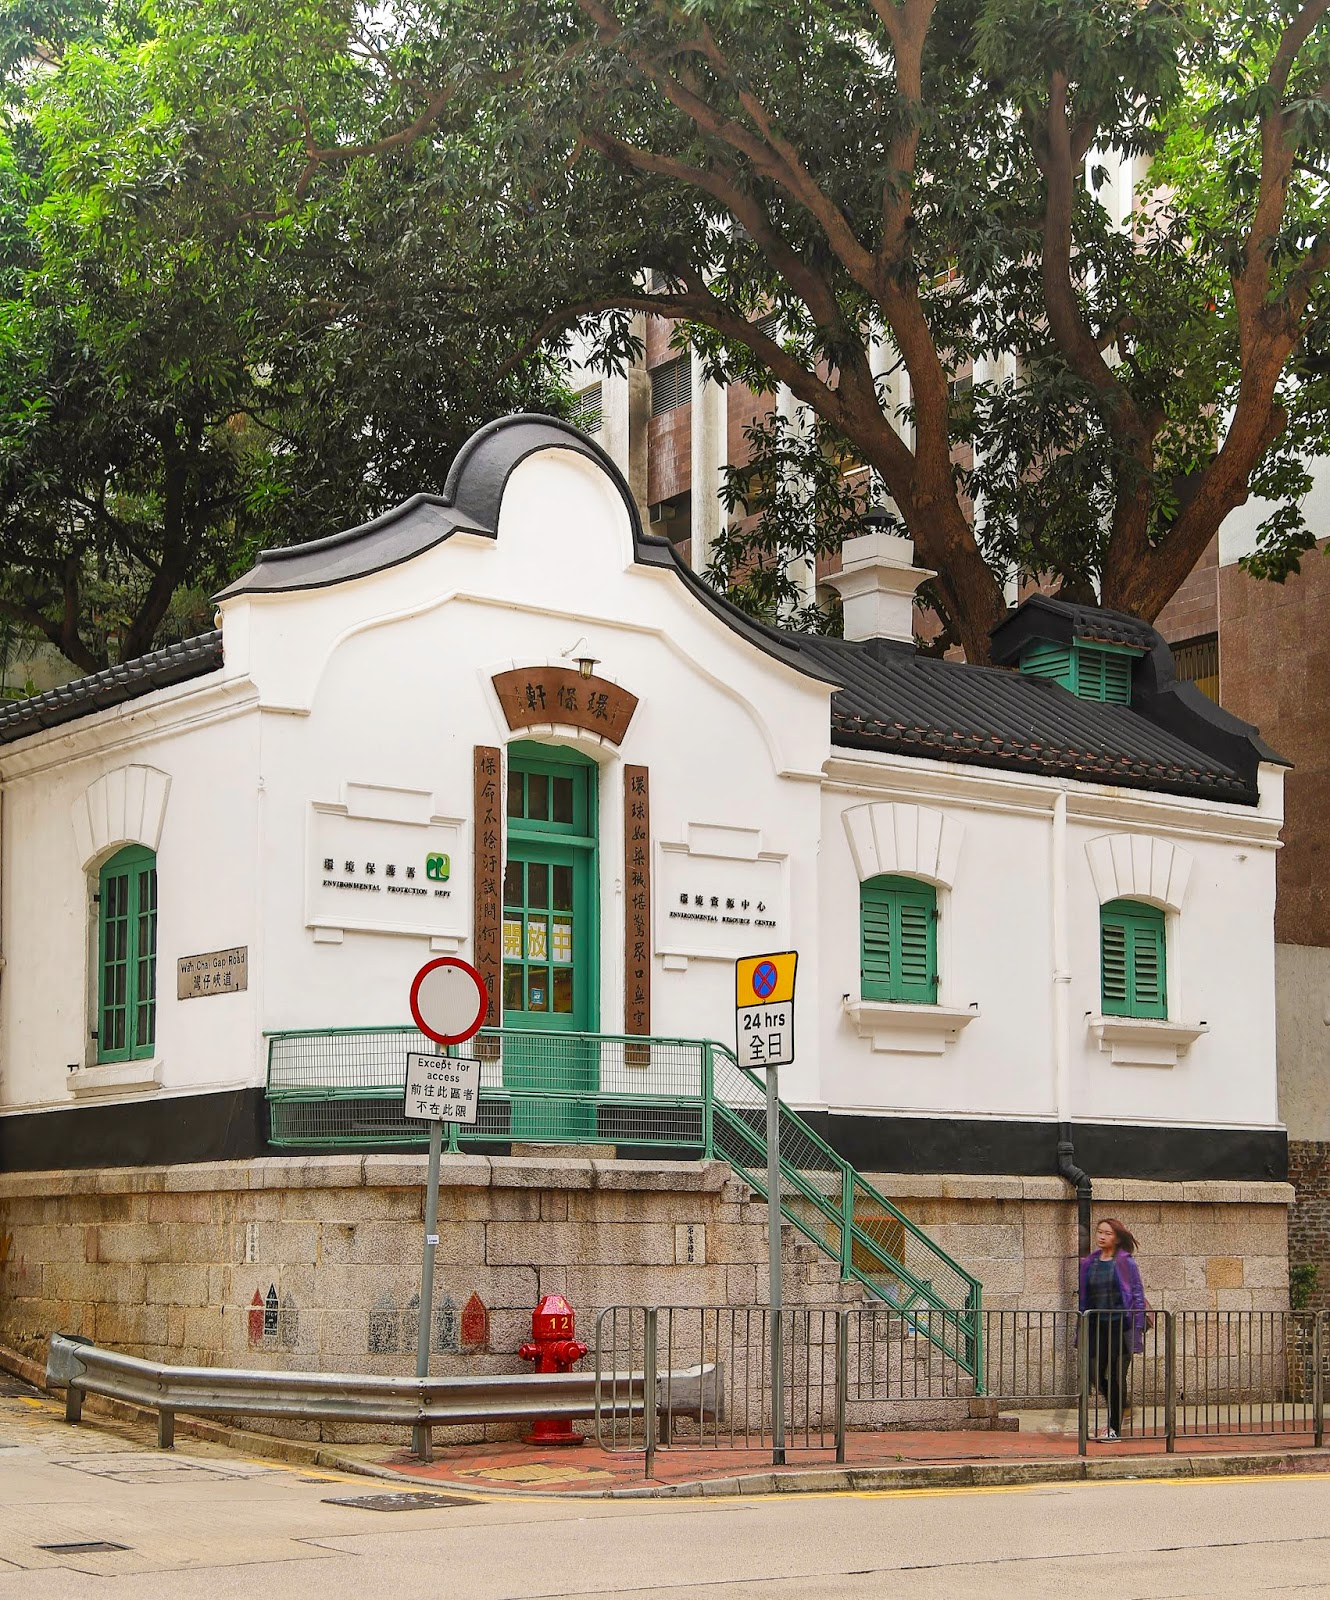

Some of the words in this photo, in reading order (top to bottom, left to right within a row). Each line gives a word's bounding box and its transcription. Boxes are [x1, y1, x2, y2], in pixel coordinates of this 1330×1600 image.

[323, 858, 417, 879] 環境保護署
[323, 880, 381, 891] ENVIRONMENTAL
[388, 886, 427, 896] PROTECTION
[680, 893, 766, 912] 環境資源中心
[670, 911, 719, 922] ENVIRONMENTAL
[722, 916, 750, 925] RESOURCE
[754, 919, 776, 927] CENTRE
[503, 924, 572, 959] 開放中
[212, 957, 226, 969] Gap
[228, 954, 245, 965] Road
[193, 971, 232, 991] 灣仔峽道
[743, 1012, 762, 1030] 24
[765, 1011, 786, 1028] hrs
[749, 1032, 782, 1060] 全日
[417, 1057, 452, 1070] Except
[456, 1062, 471, 1072] for
[427, 1072, 460, 1083] access
[410, 1083, 475, 1101] 前往此區者
[416, 1100, 467, 1118] 不在此限
